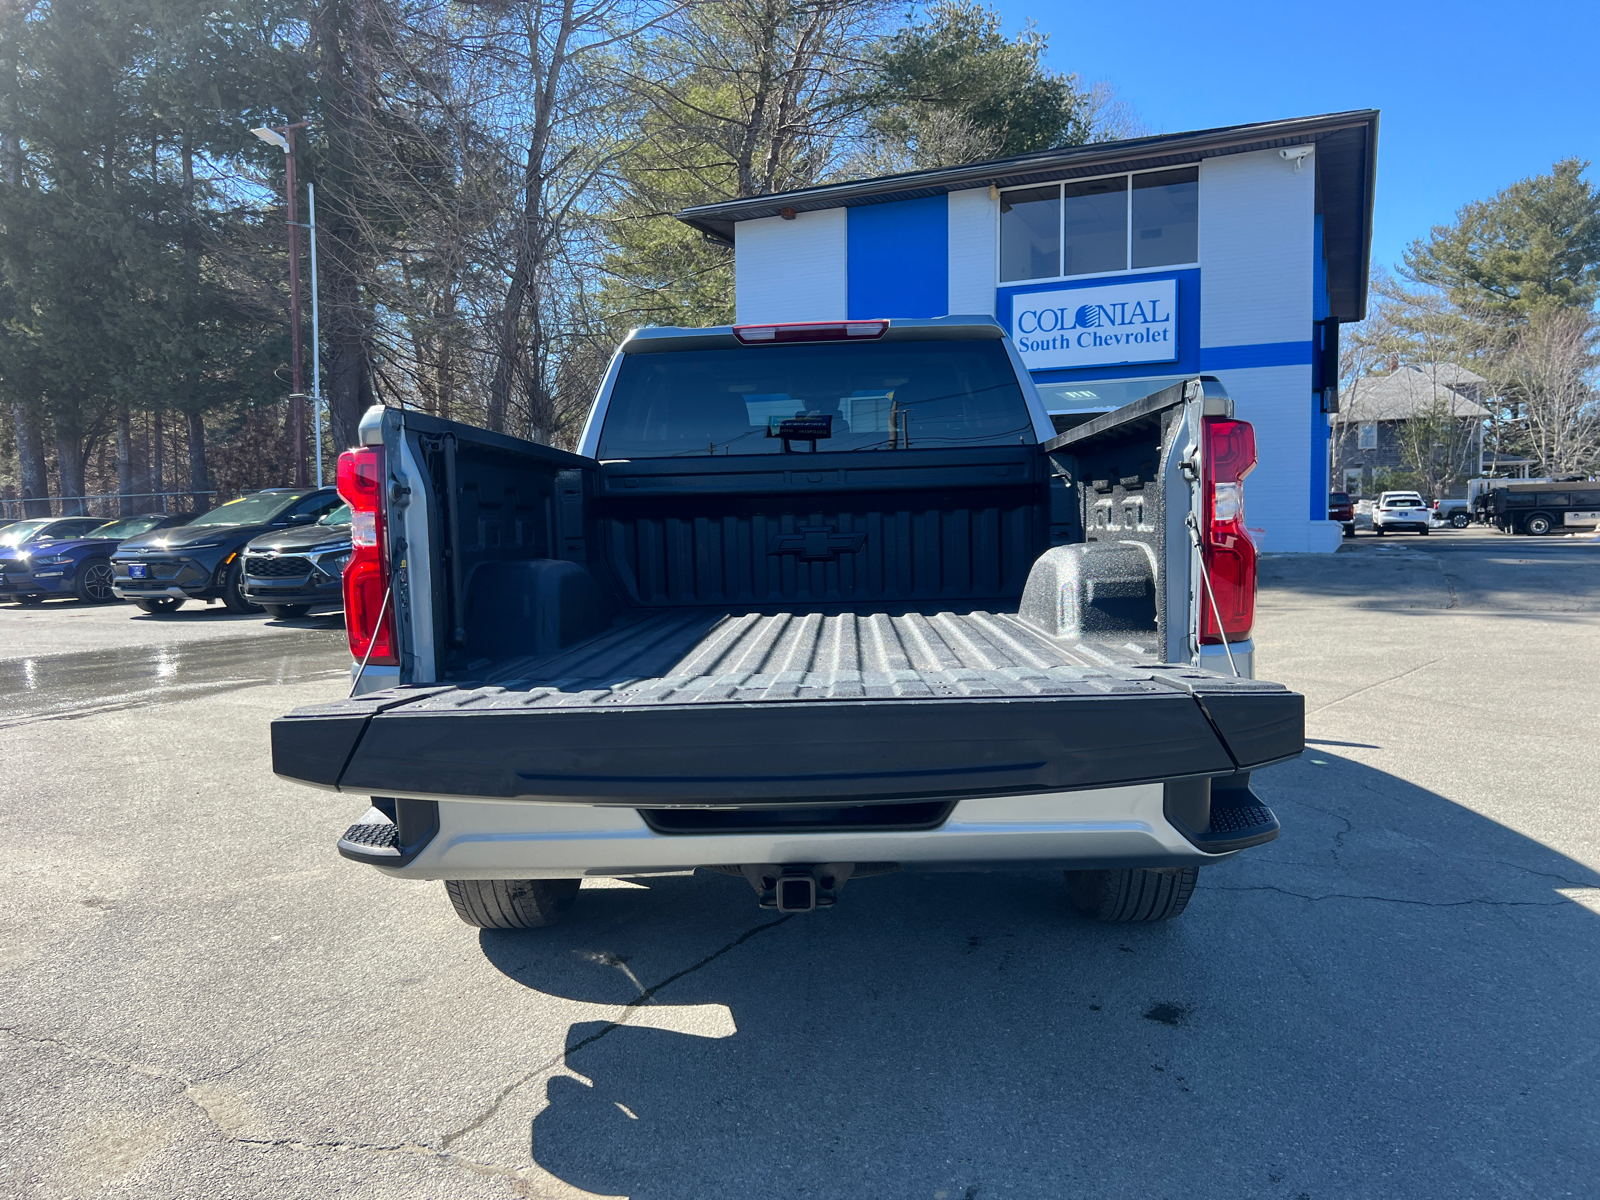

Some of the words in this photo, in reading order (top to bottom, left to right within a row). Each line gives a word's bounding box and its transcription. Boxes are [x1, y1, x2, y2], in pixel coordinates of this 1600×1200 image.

[1017, 299, 1170, 334] COLONIAL
[1018, 334, 1070, 353] South
[1076, 327, 1170, 348] Chevrolet
